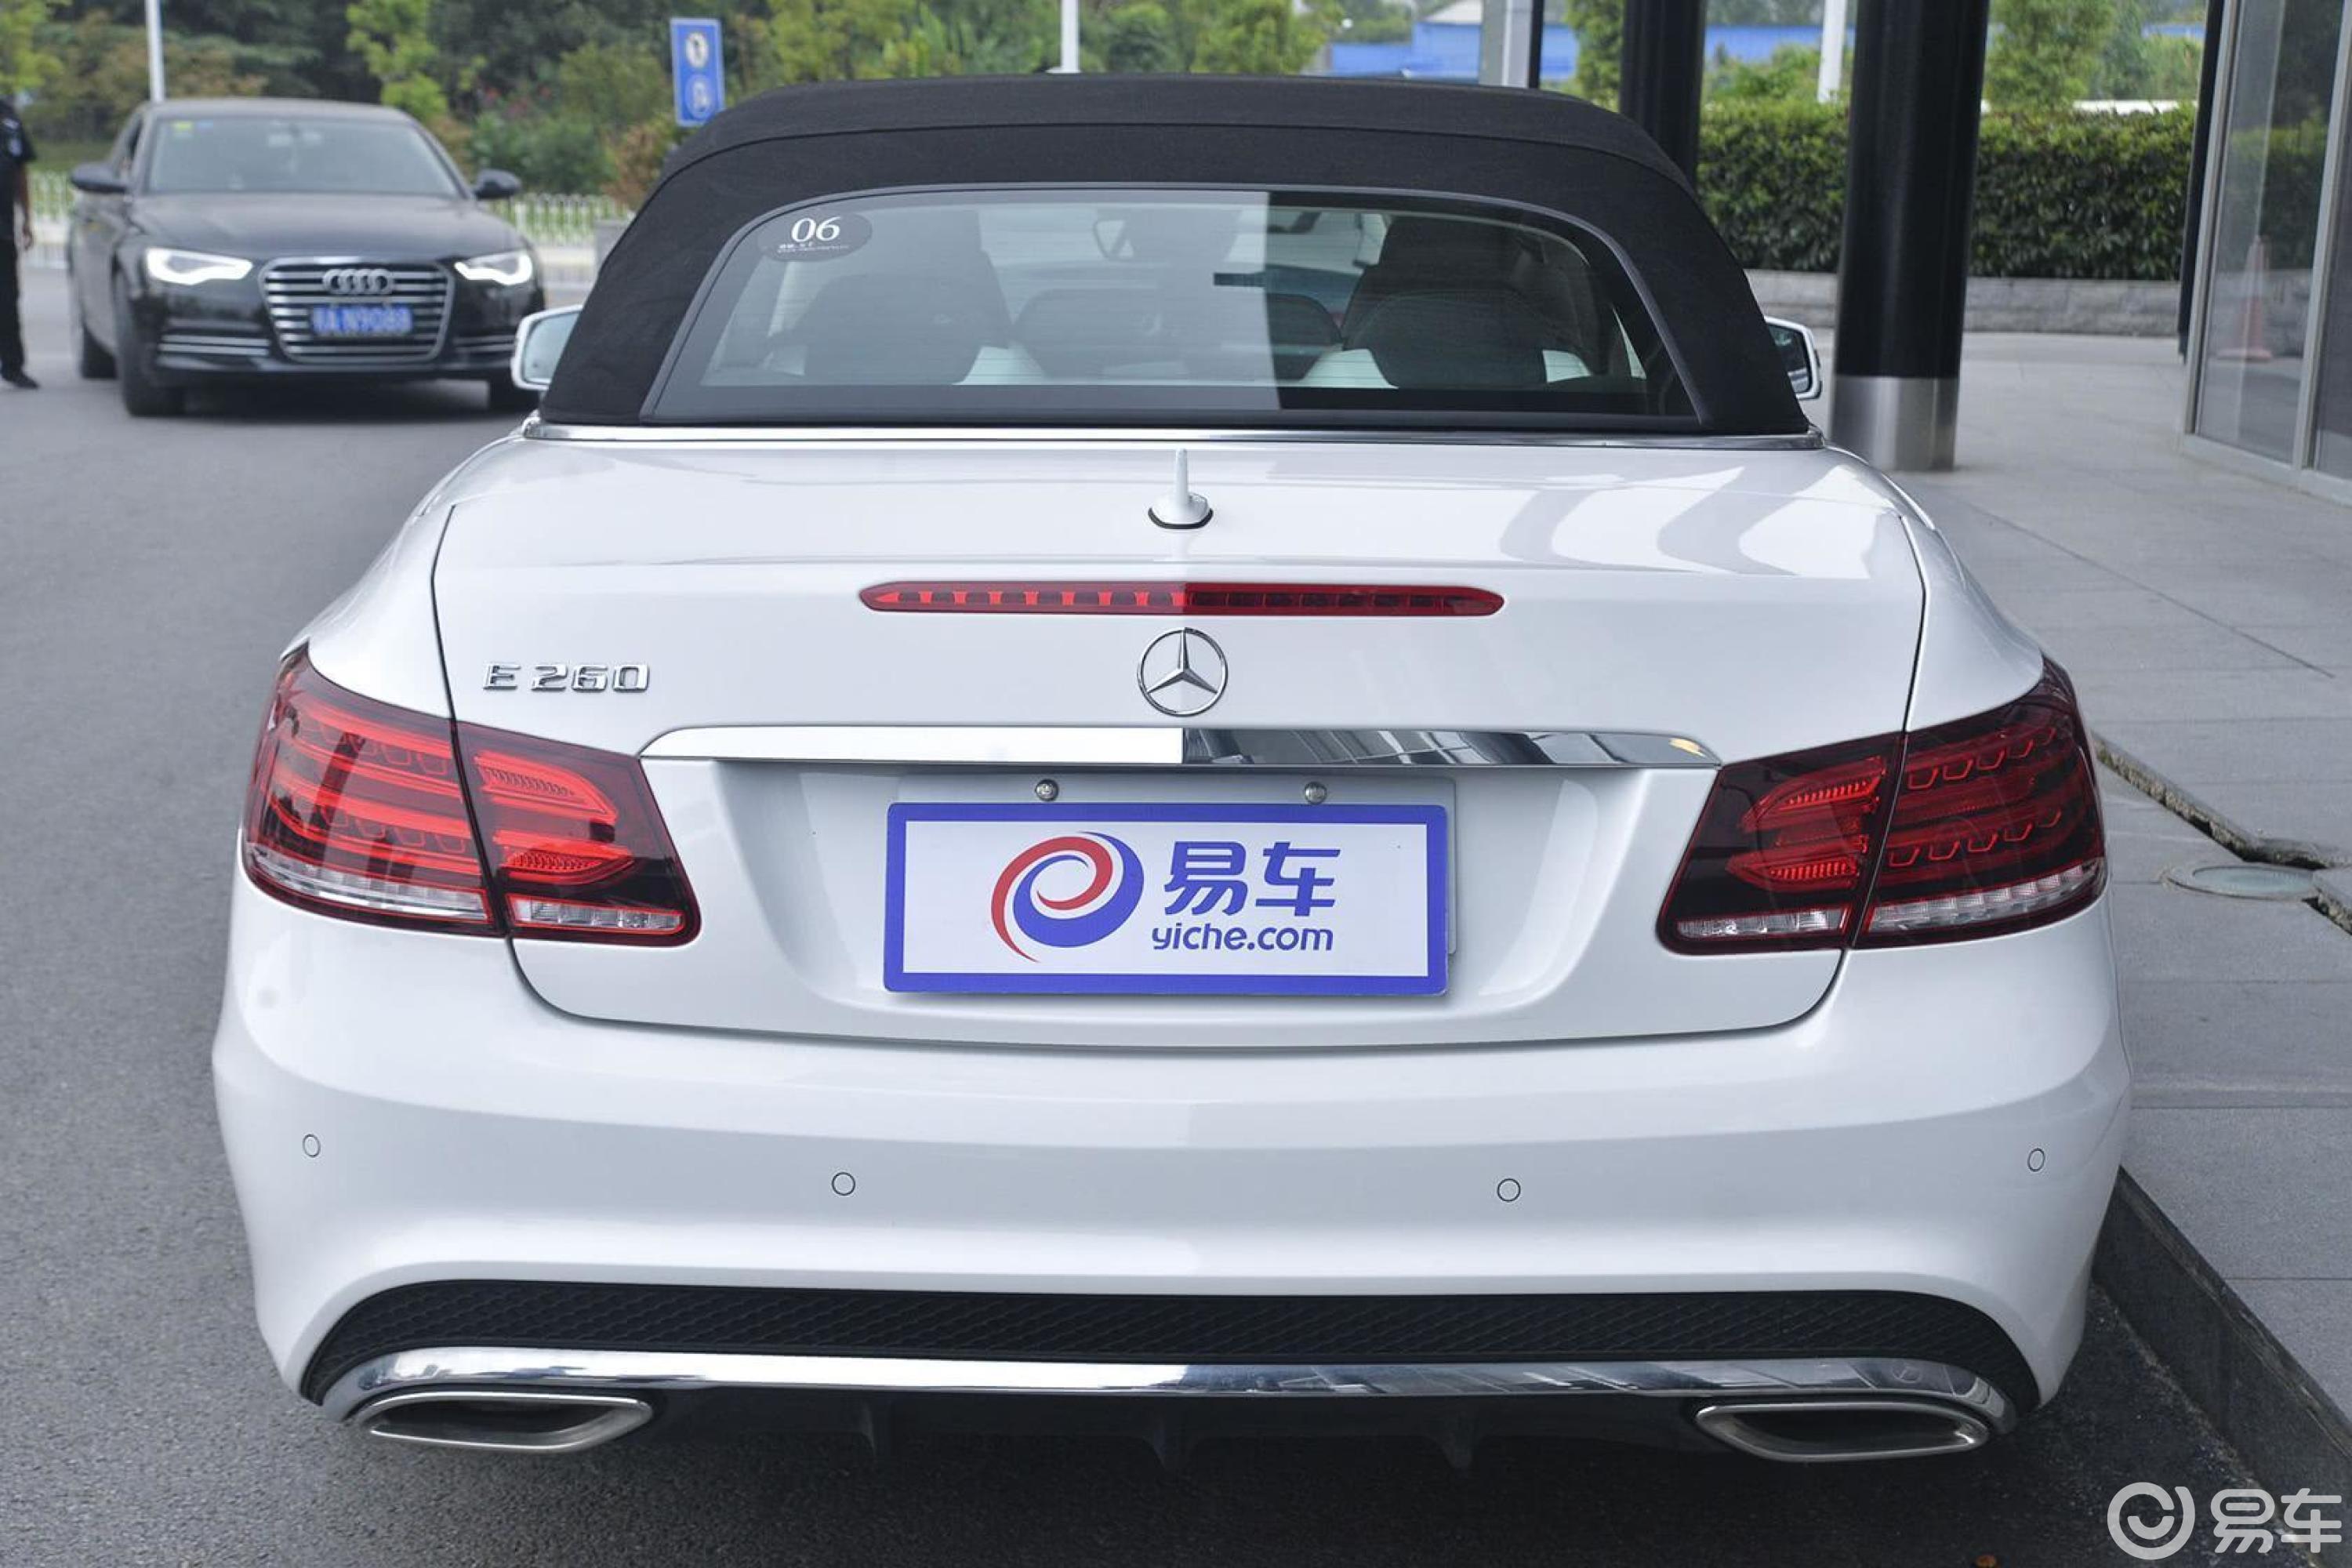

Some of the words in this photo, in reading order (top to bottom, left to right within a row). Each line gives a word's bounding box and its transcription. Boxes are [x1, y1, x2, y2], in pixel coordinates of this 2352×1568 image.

[791, 216, 840, 242] 06
[482, 662, 521, 690] E
[531, 663, 650, 693] 260
[1164, 841, 1341, 916] 易车
[1152, 923, 1333, 950] yiche.com
